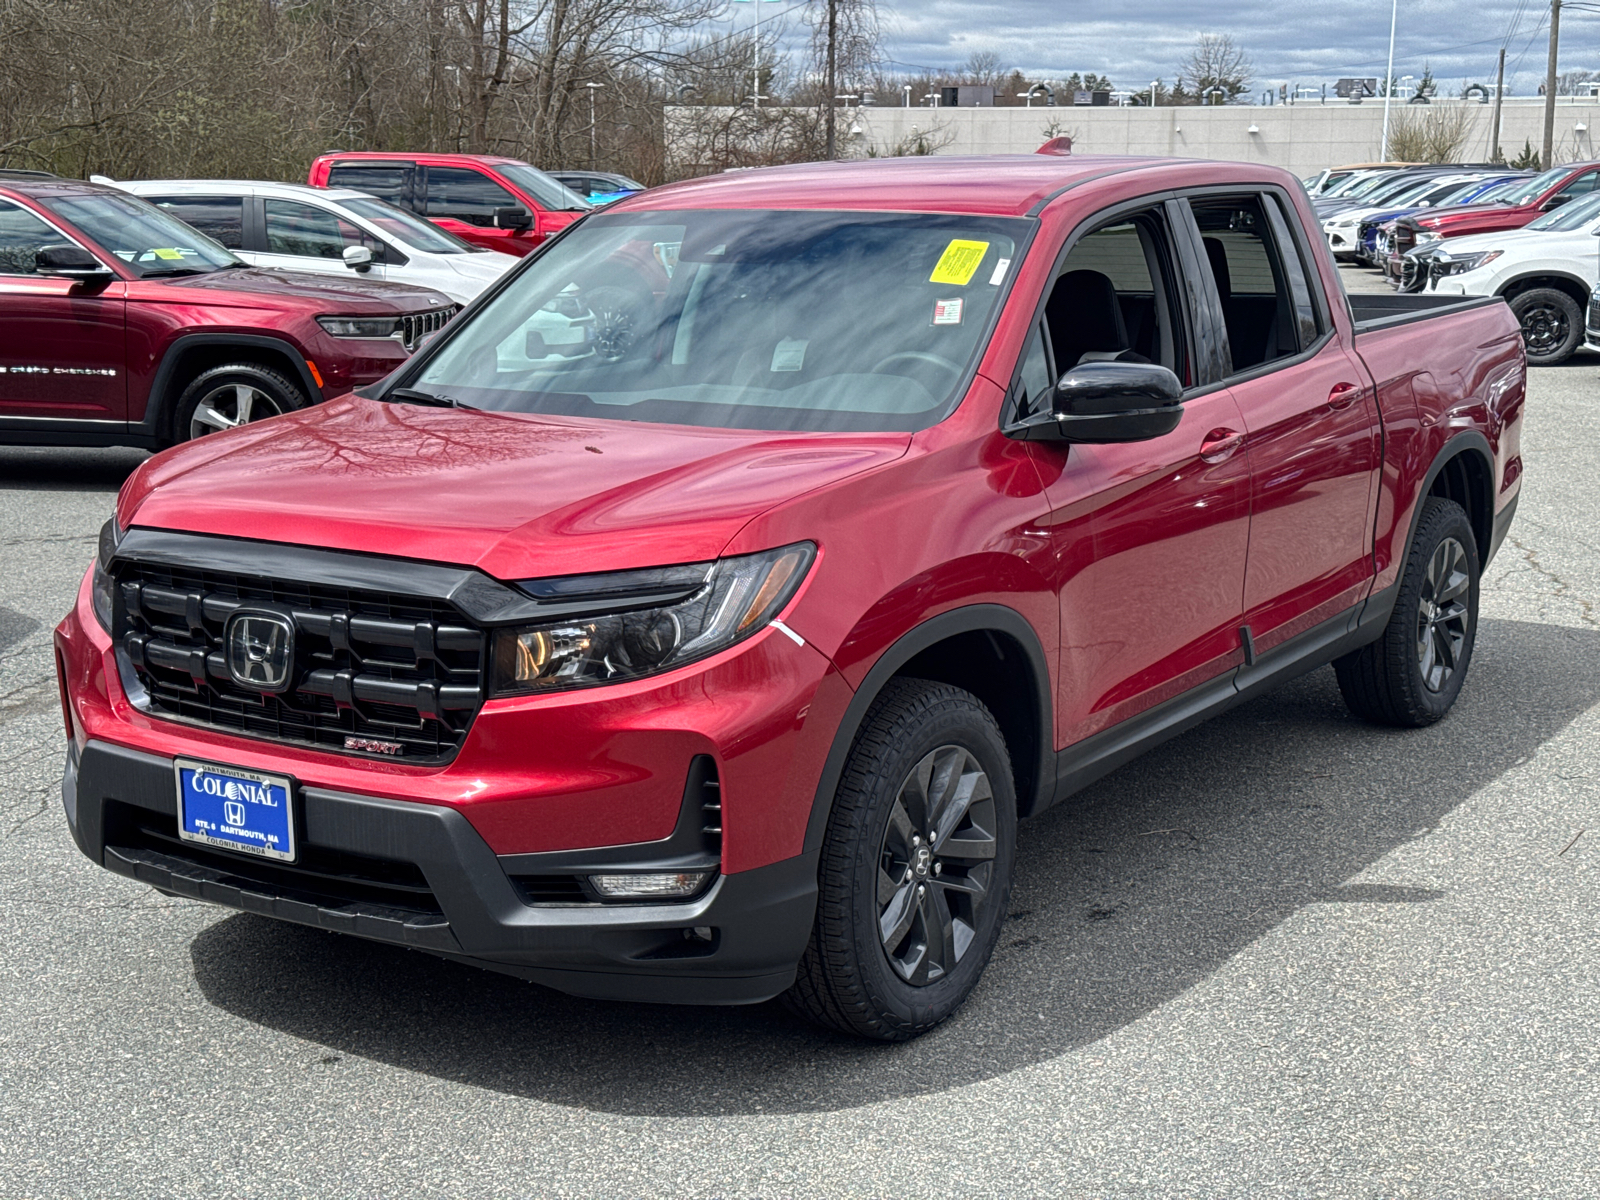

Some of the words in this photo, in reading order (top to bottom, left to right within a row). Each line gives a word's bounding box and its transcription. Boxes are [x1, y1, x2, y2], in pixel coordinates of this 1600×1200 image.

[344, 736, 402, 755] SPORT
[249, 773, 261, 781] MA
[191, 773, 278, 807] COLONIAL
[211, 823, 216, 831] 6
[220, 824, 266, 841] DARTMOUTH,
[267, 834, 279, 844] MA
[206, 837, 240, 850] COLONIAL
[241, 843, 266, 855] HONDA
